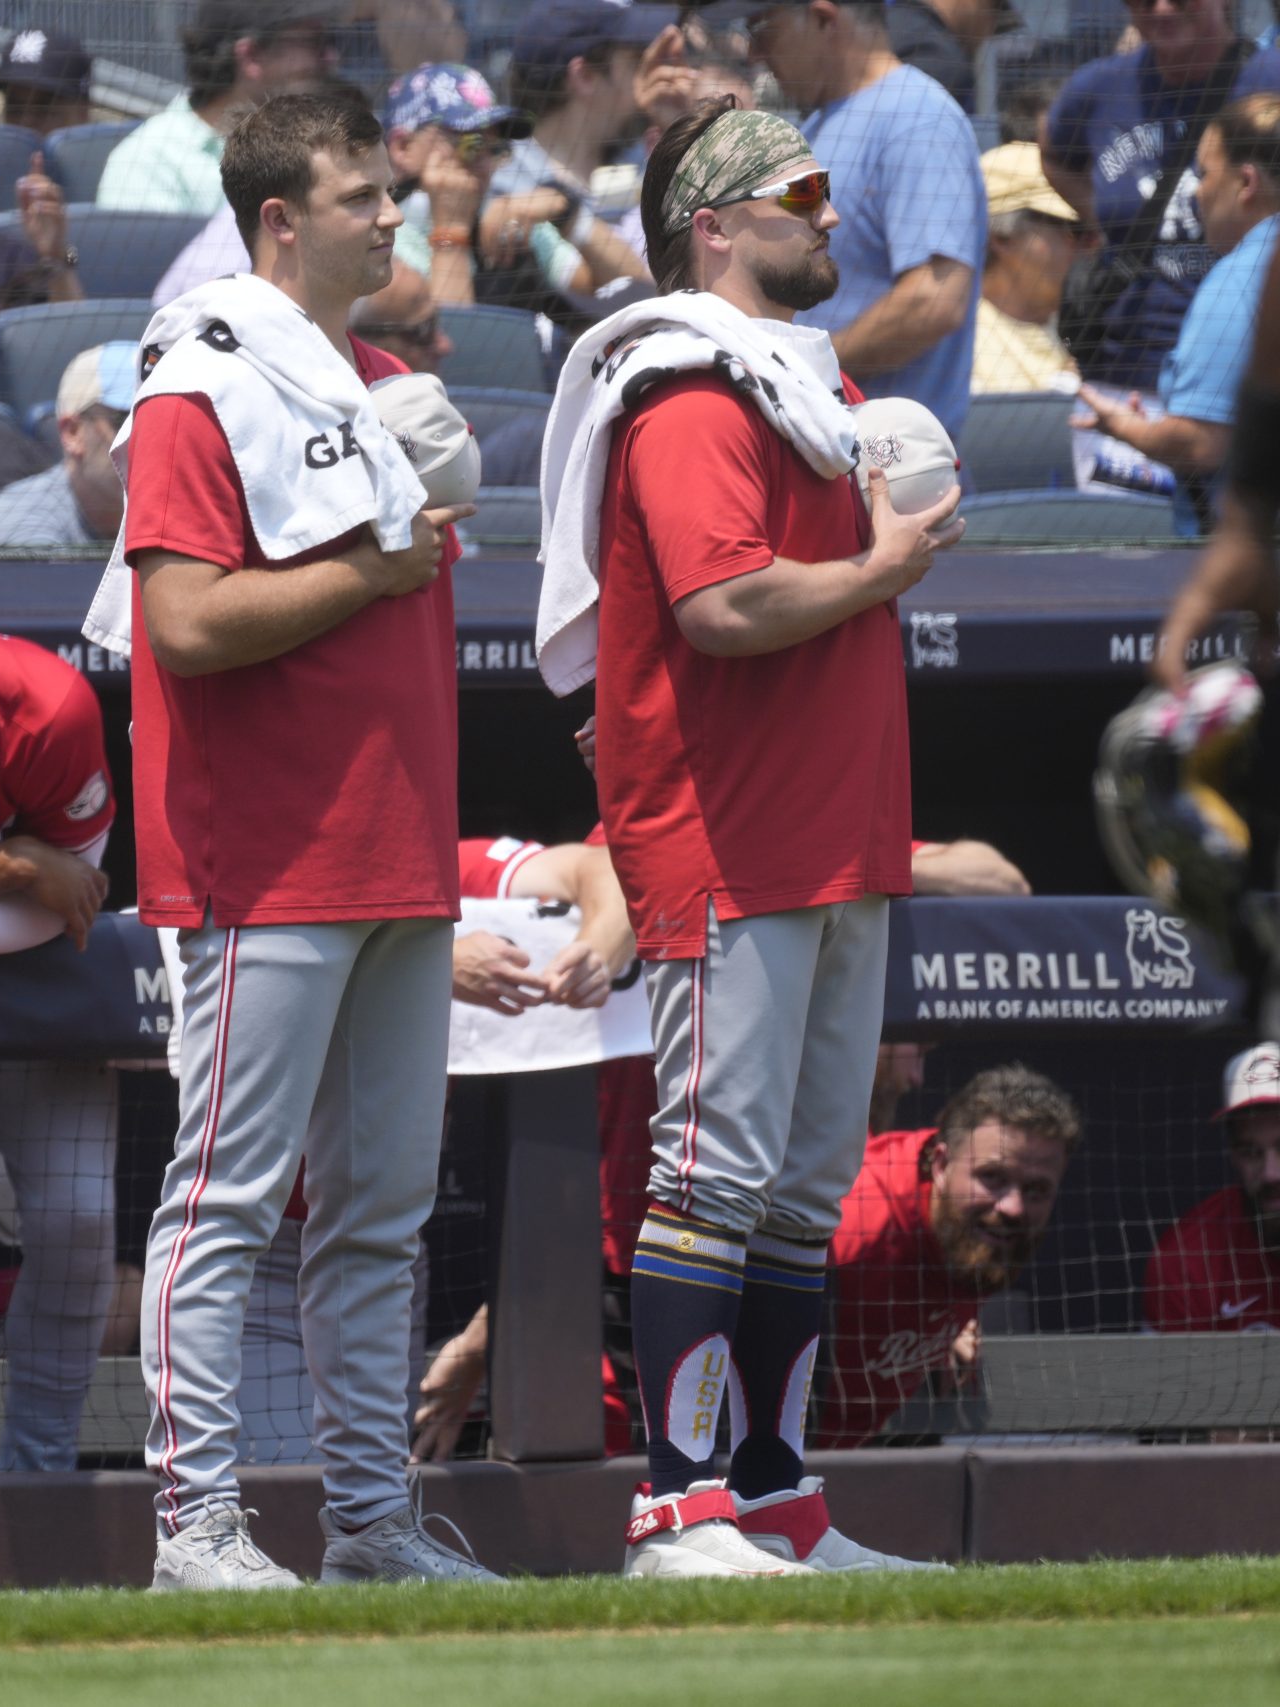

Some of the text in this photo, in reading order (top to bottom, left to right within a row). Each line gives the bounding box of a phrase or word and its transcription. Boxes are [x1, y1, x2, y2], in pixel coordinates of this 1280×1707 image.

[911, 953, 1120, 990] MERRILL
[917, 1000, 1229, 1019] A BANK OF AMERICA COMPANY
[692, 1350, 725, 1441] USA
[631, 1512, 658, 1538] 24
